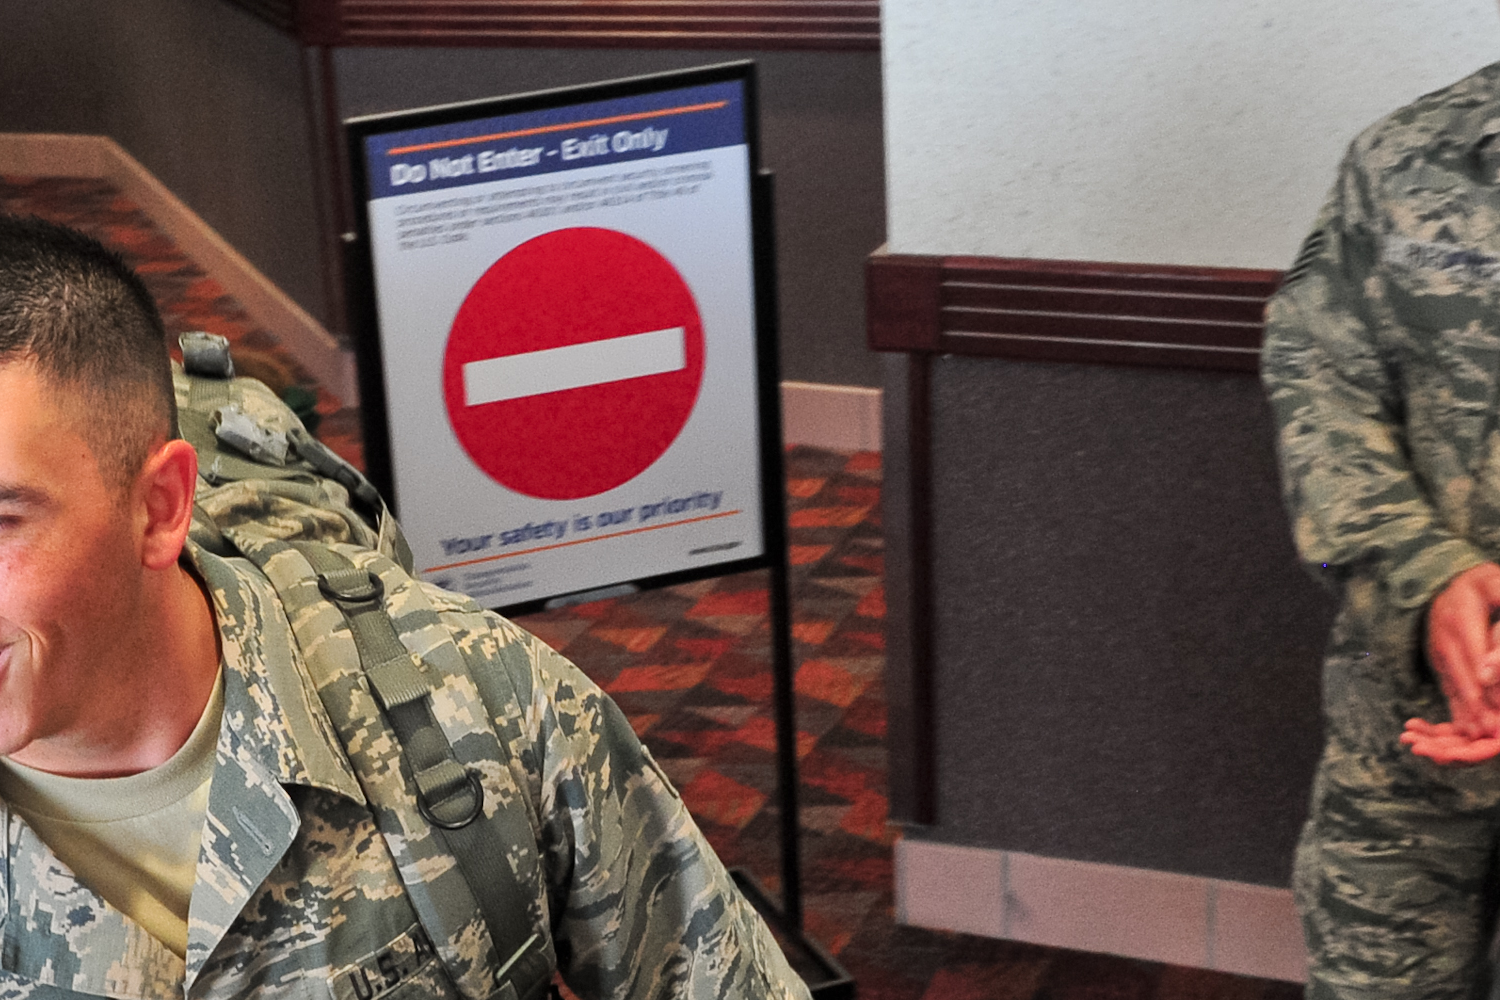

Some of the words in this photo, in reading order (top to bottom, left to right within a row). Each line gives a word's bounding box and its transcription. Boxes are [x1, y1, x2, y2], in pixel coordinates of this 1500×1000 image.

[390, 163, 427, 186] Do
[429, 154, 475, 181] Not
[477, 146, 544, 174] Enter
[561, 133, 610, 161] Exit
[611, 127, 669, 152] Only
[440, 533, 494, 556] Your
[498, 520, 568, 546] safety
[572, 513, 594, 533] is
[596, 507, 635, 528] our
[638, 490, 723, 523] priority
